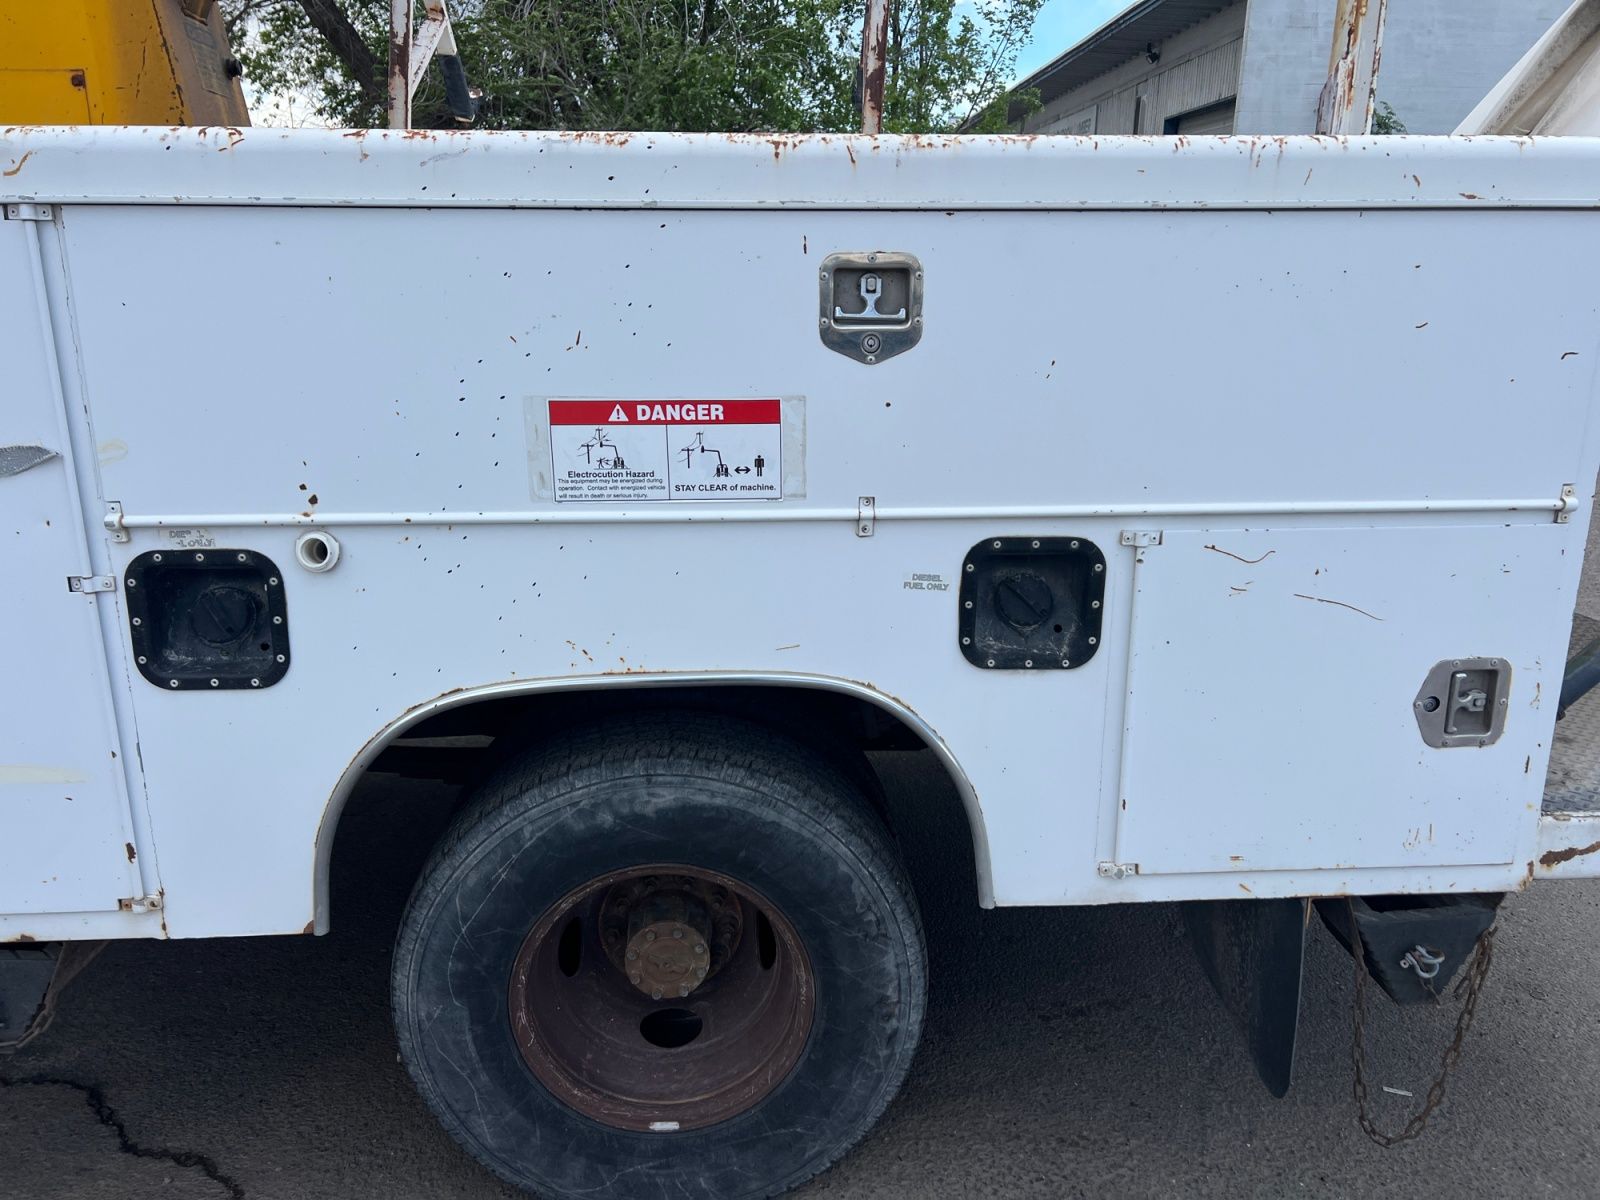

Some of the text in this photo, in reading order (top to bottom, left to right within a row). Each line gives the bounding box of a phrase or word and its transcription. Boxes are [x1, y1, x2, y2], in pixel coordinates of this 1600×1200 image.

[636, 404, 724, 421] DANGER
[567, 470, 655, 479] Electrocution Hazard
[620, 478, 645, 486] energized
[674, 483, 777, 492] STAY CLEAR of machine.
[912, 573, 943, 582] DIESEL
[903, 581, 949, 591] FUEL ONLY
